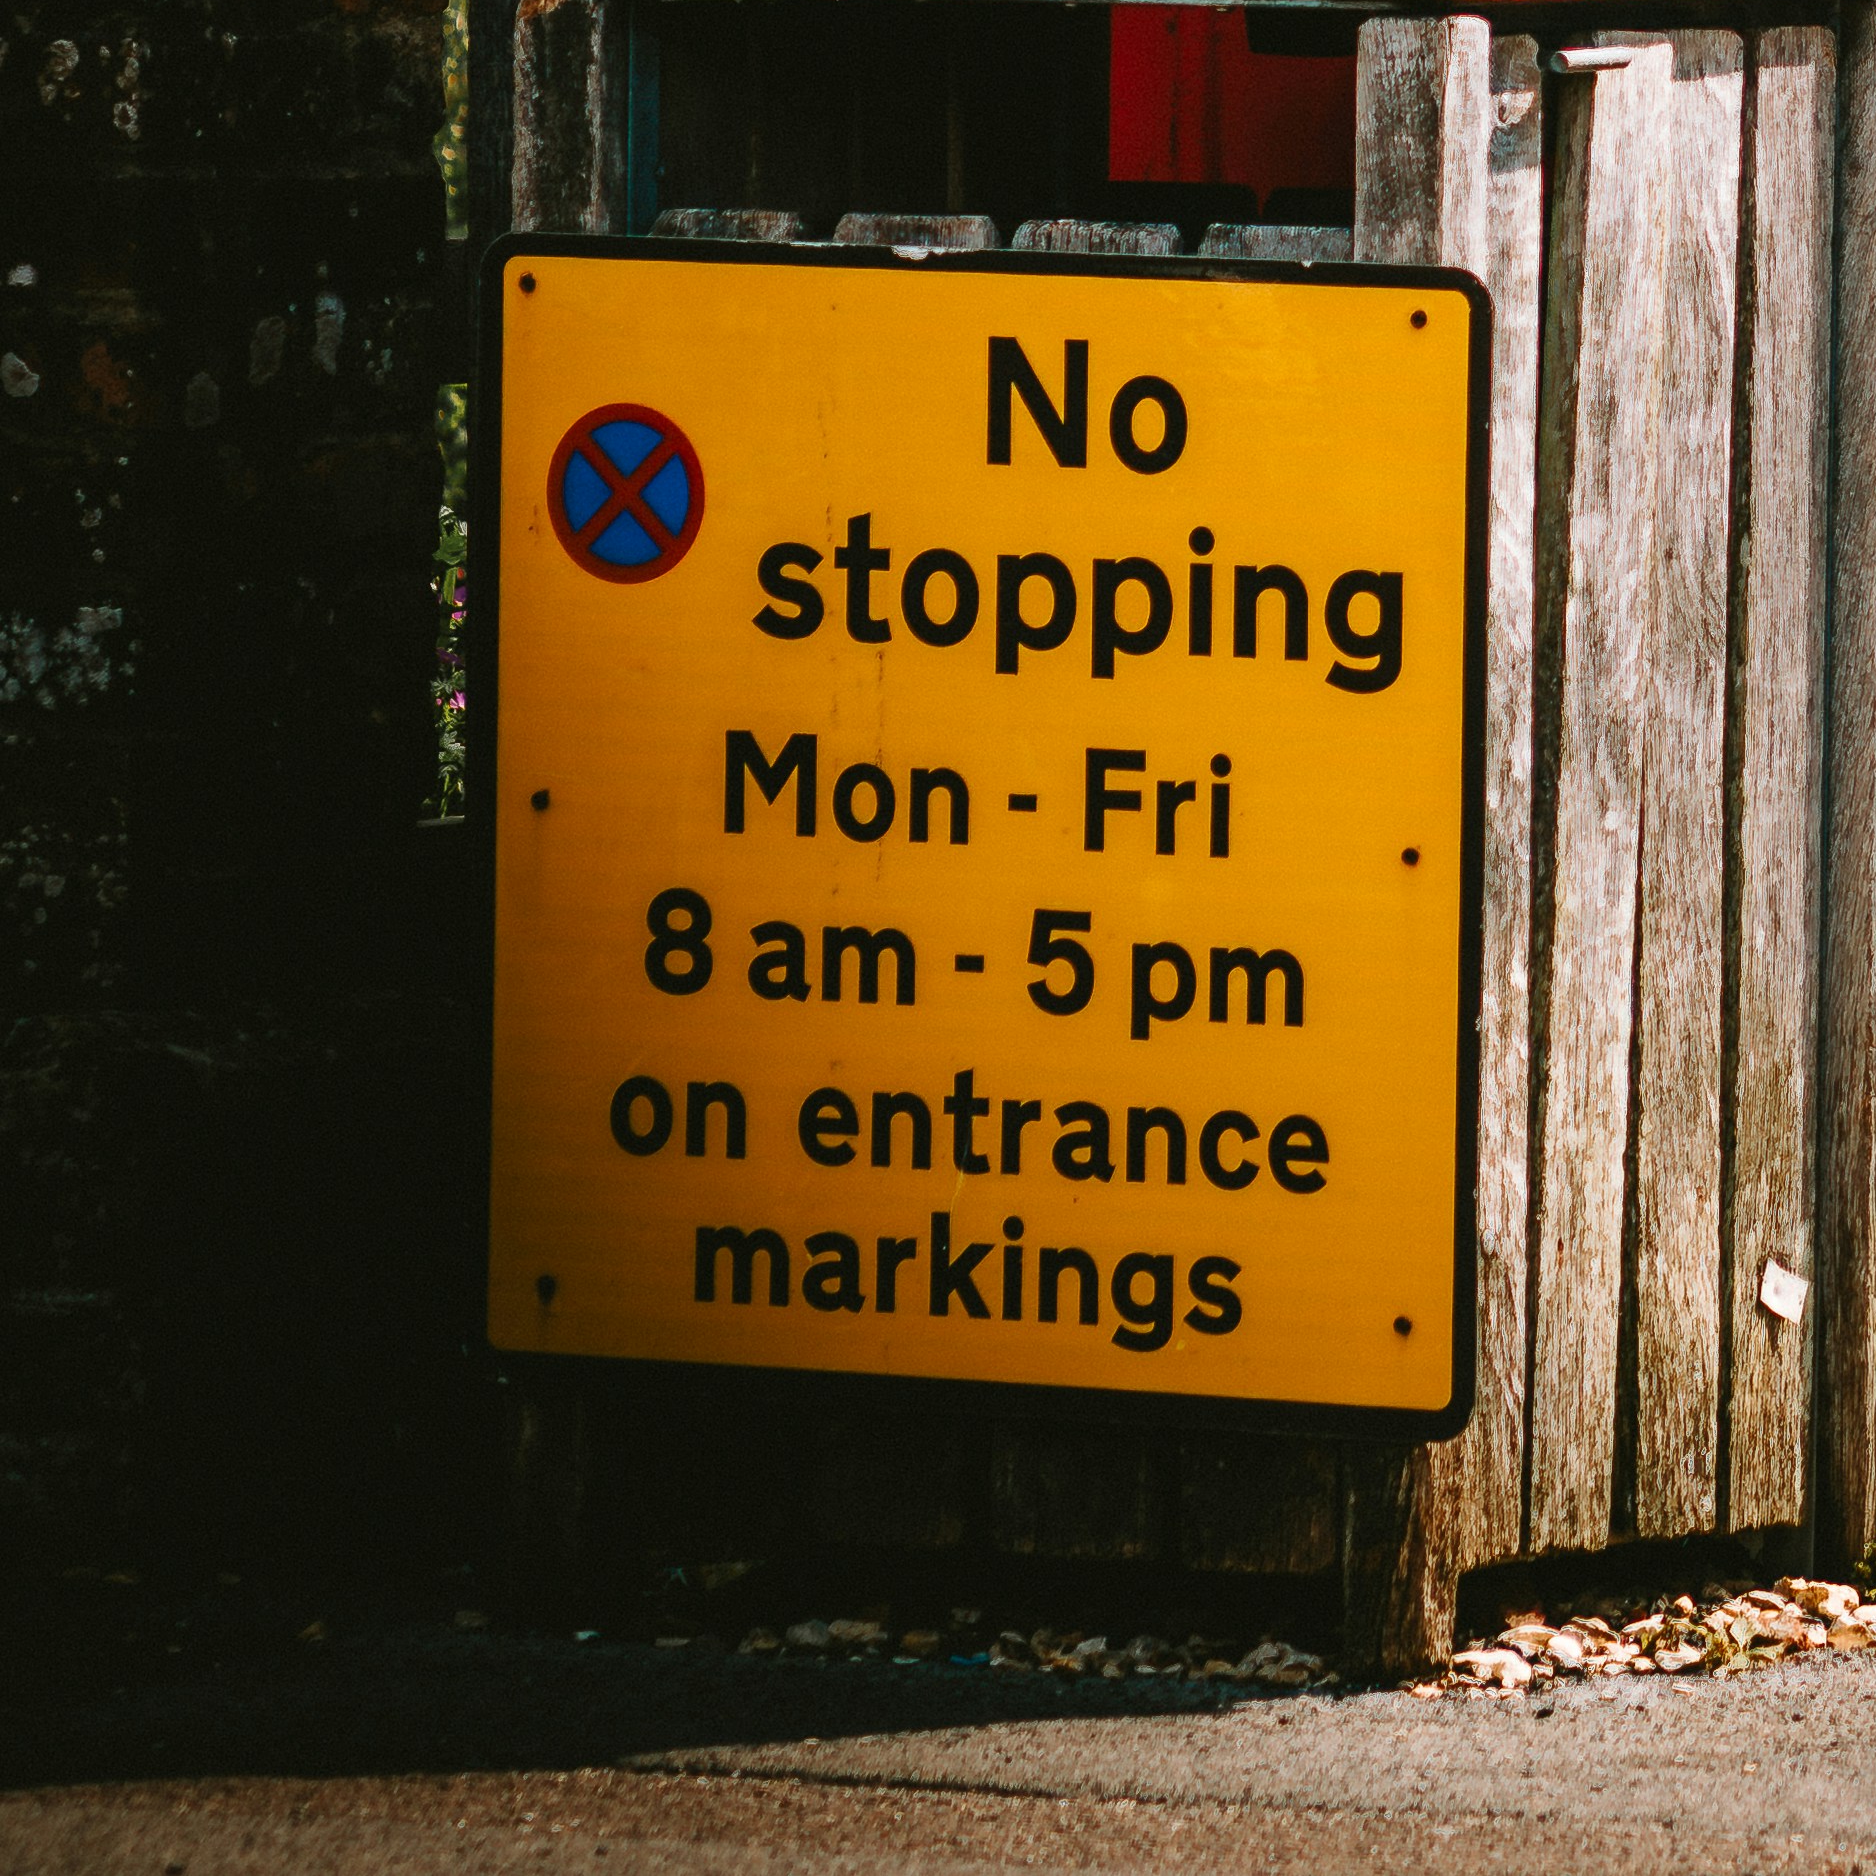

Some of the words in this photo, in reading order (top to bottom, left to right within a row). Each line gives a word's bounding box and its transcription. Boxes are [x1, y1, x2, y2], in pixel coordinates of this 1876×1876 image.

[986, 335, 1189, 475] No
[752, 511, 1404, 694] stopping
[723, 729, 971, 846] Mon
[1083, 747, 1233, 859] Fri
[643, 886, 715, 997] 8
[746, 919, 917, 1007] am
[1026, 908, 1096, 1017] 5
[1129, 941, 1305, 1042] pm
[606, 1073, 748, 1161] on
[796, 1068, 1331, 1195] entrance
[686, 1210, 1244, 1354] markings
